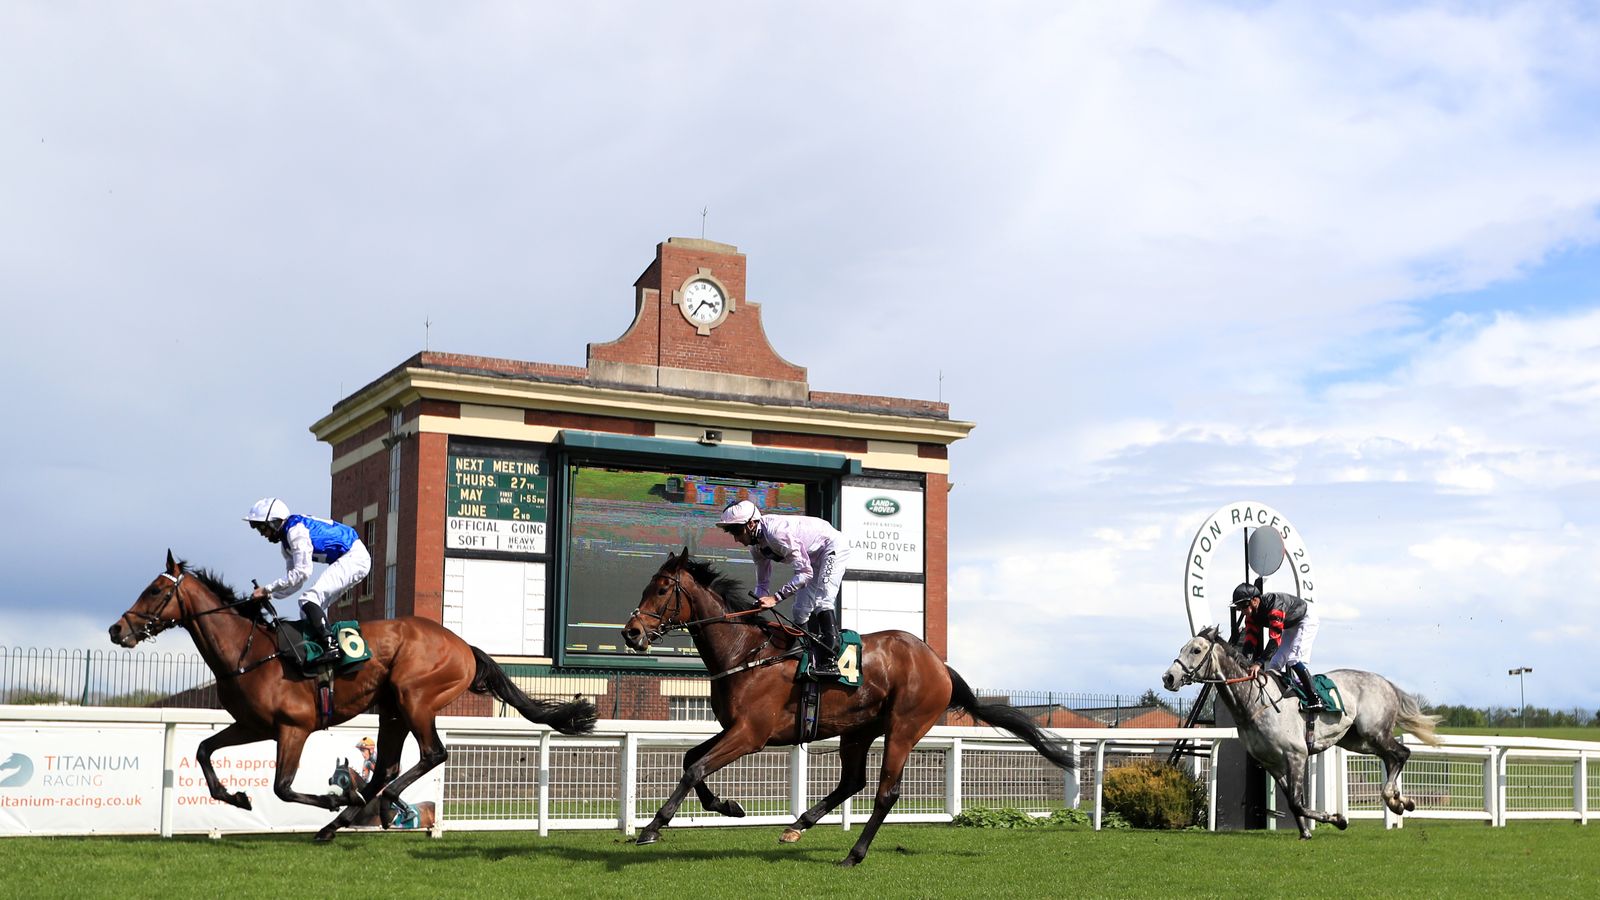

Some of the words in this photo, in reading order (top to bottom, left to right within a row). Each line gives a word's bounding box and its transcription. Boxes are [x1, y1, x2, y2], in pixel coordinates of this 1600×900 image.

[455, 458, 485, 471] NEXT
[493, 460, 540, 475] MEETING
[455, 473, 497, 487] THURS.
[460, 488, 483, 501] MAY
[457, 504, 487, 517] JUNE
[450, 519, 500, 532] OFFICIAL
[511, 523, 544, 535] GOING
[458, 535, 487, 546] SOFT
[508, 536, 535, 545] HEAVY
[866, 530, 900, 540] LLOYD
[848, 540, 877, 550] LAND
[881, 542, 916, 552] ROVER
[866, 552, 899, 562] RIPON
[1192, 521, 1222, 599] RIPON
[1231, 507, 1291, 540] RACES
[1293, 548, 1315, 604] 2021
[338, 627, 365, 658] 6
[837, 644, 860, 683] 4
[44, 755, 139, 771] TITANIUM
[179, 756, 190, 768] A
[236, 759, 300, 771] appro
[43, 774, 103, 787] RACING
[178, 775, 194, 787] to
[198, 774, 269, 787] rehorse
